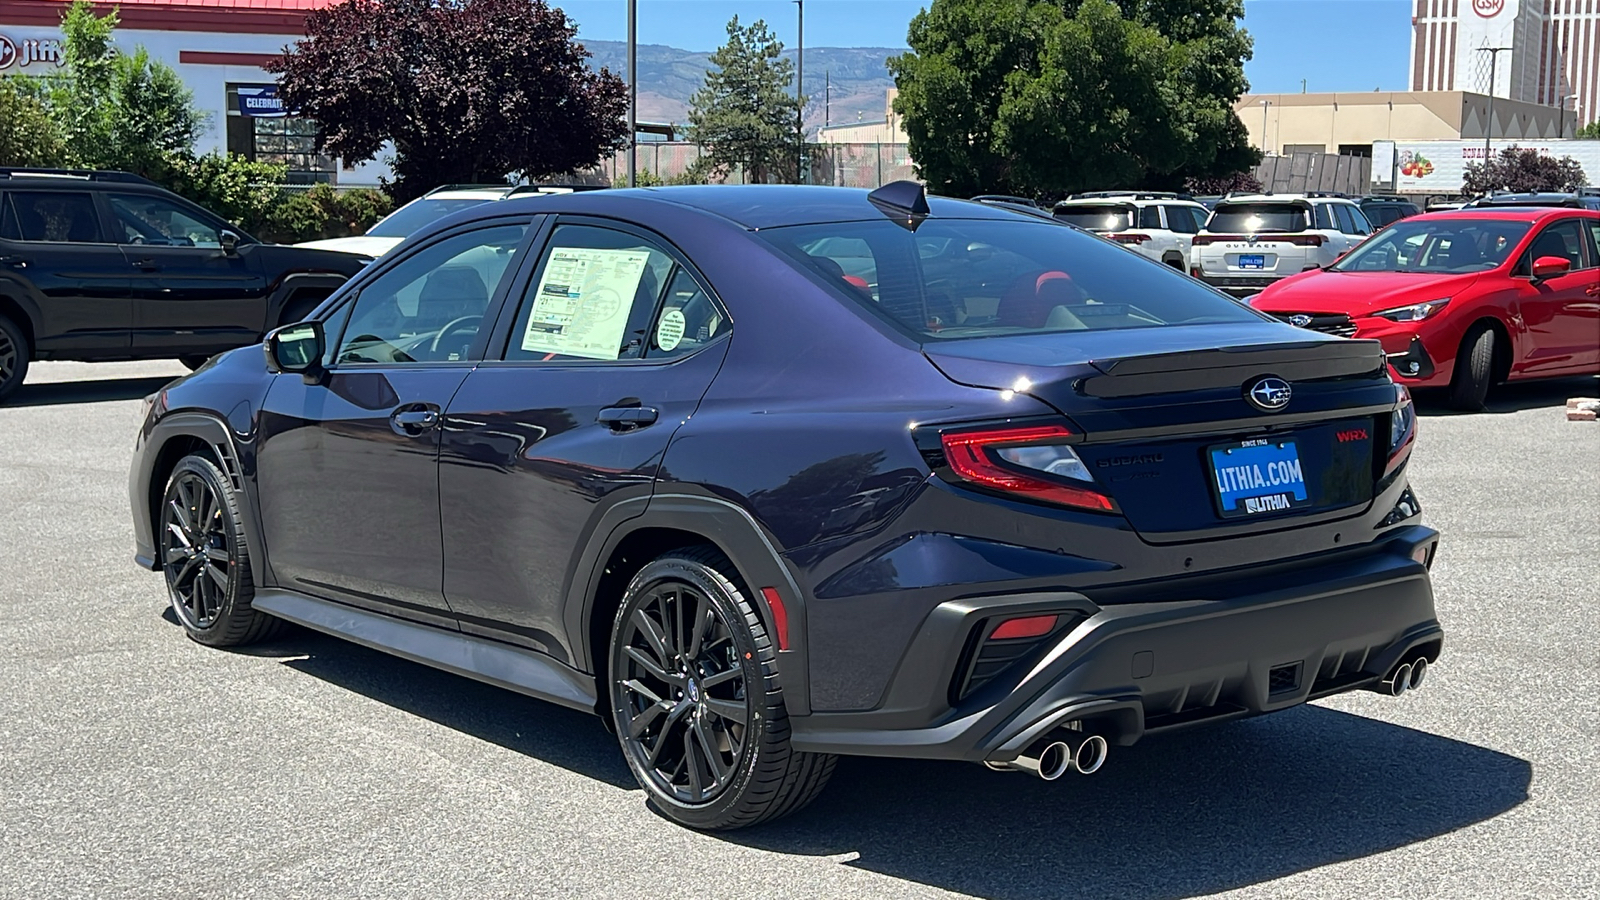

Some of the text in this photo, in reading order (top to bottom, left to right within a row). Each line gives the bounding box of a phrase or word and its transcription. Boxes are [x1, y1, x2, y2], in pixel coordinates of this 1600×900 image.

[1336, 429, 1369, 443] WRX
[1096, 453, 1165, 468] SUBARU
[1215, 458, 1304, 493] LITHIA.COM
[1255, 494, 1291, 512] LITHIA
